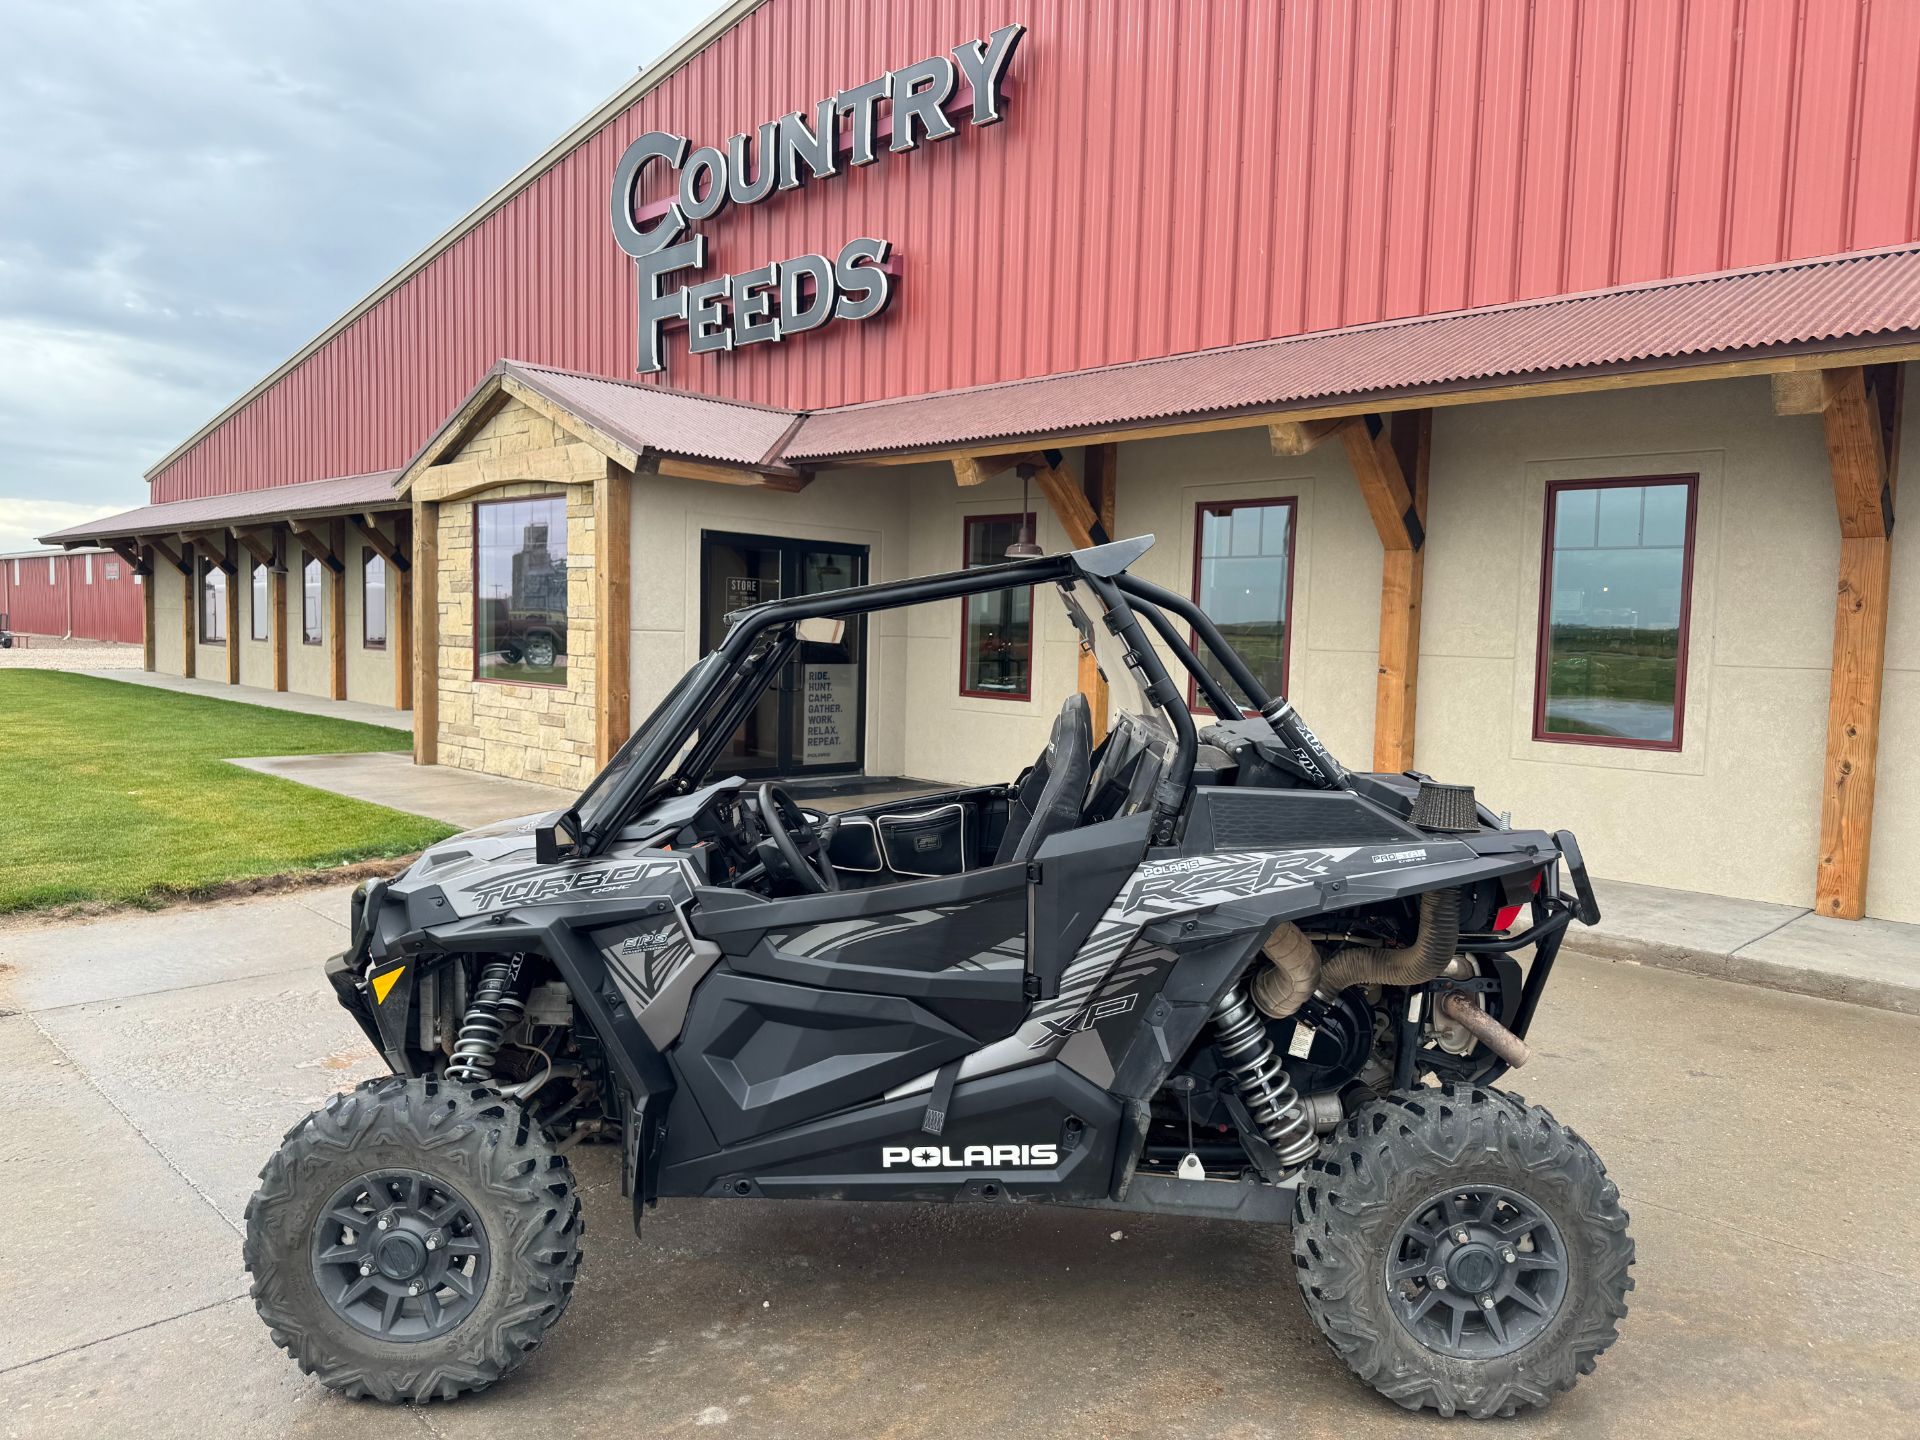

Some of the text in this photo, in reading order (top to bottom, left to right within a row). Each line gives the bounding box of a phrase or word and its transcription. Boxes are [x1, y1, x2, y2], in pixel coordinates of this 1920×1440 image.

[610, 23, 1026, 258] COUNTRY
[635, 233, 892, 374] FEEDS
[731, 580, 757, 591] STORE
[808, 671, 831, 681] RIDE.
[808, 682, 833, 692] HUNT.
[808, 693, 834, 703] CAMP.
[808, 704, 843, 714] GATHER.
[808, 715, 835, 725] WORK.
[807, 726, 839, 736] RELAX.
[807, 737, 841, 747] REPEAT.
[1291, 747, 1325, 781] FOX
[1143, 859, 1200, 878] POLARIS
[471, 863, 649, 912] TURBO
[591, 883, 632, 894] DOHC
[1120, 851, 1341, 918] RZR
[1027, 992, 1140, 1050] XP
[881, 1143, 1059, 1168] POLARIS
